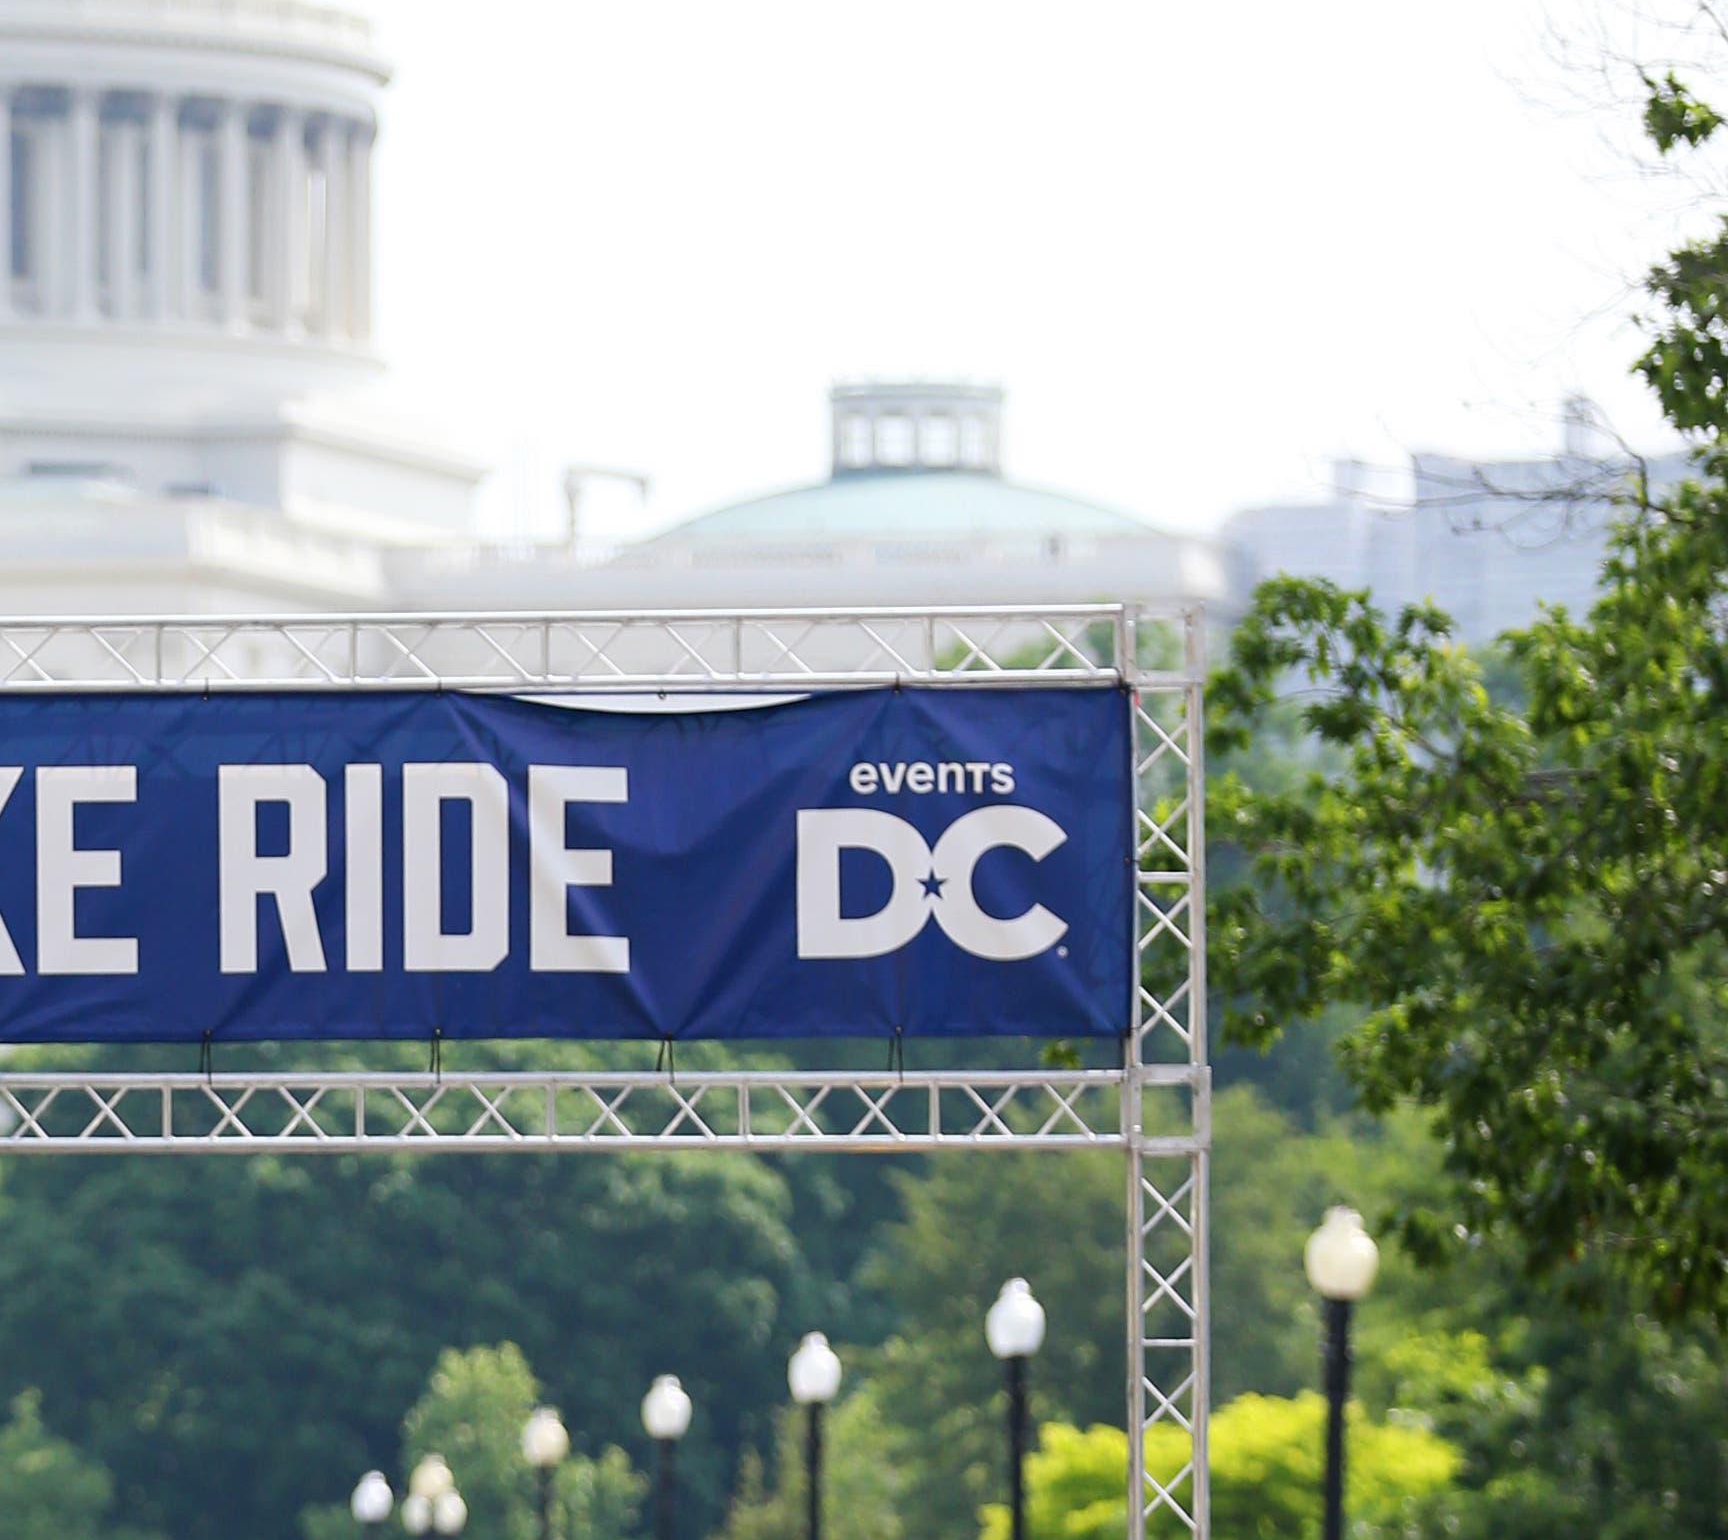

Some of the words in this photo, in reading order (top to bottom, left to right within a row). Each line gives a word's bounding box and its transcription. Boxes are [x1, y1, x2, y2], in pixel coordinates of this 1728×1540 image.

[849, 761, 1016, 795] events
[218, 762, 631, 973] RIDE
[796, 804, 1069, 961] DC
